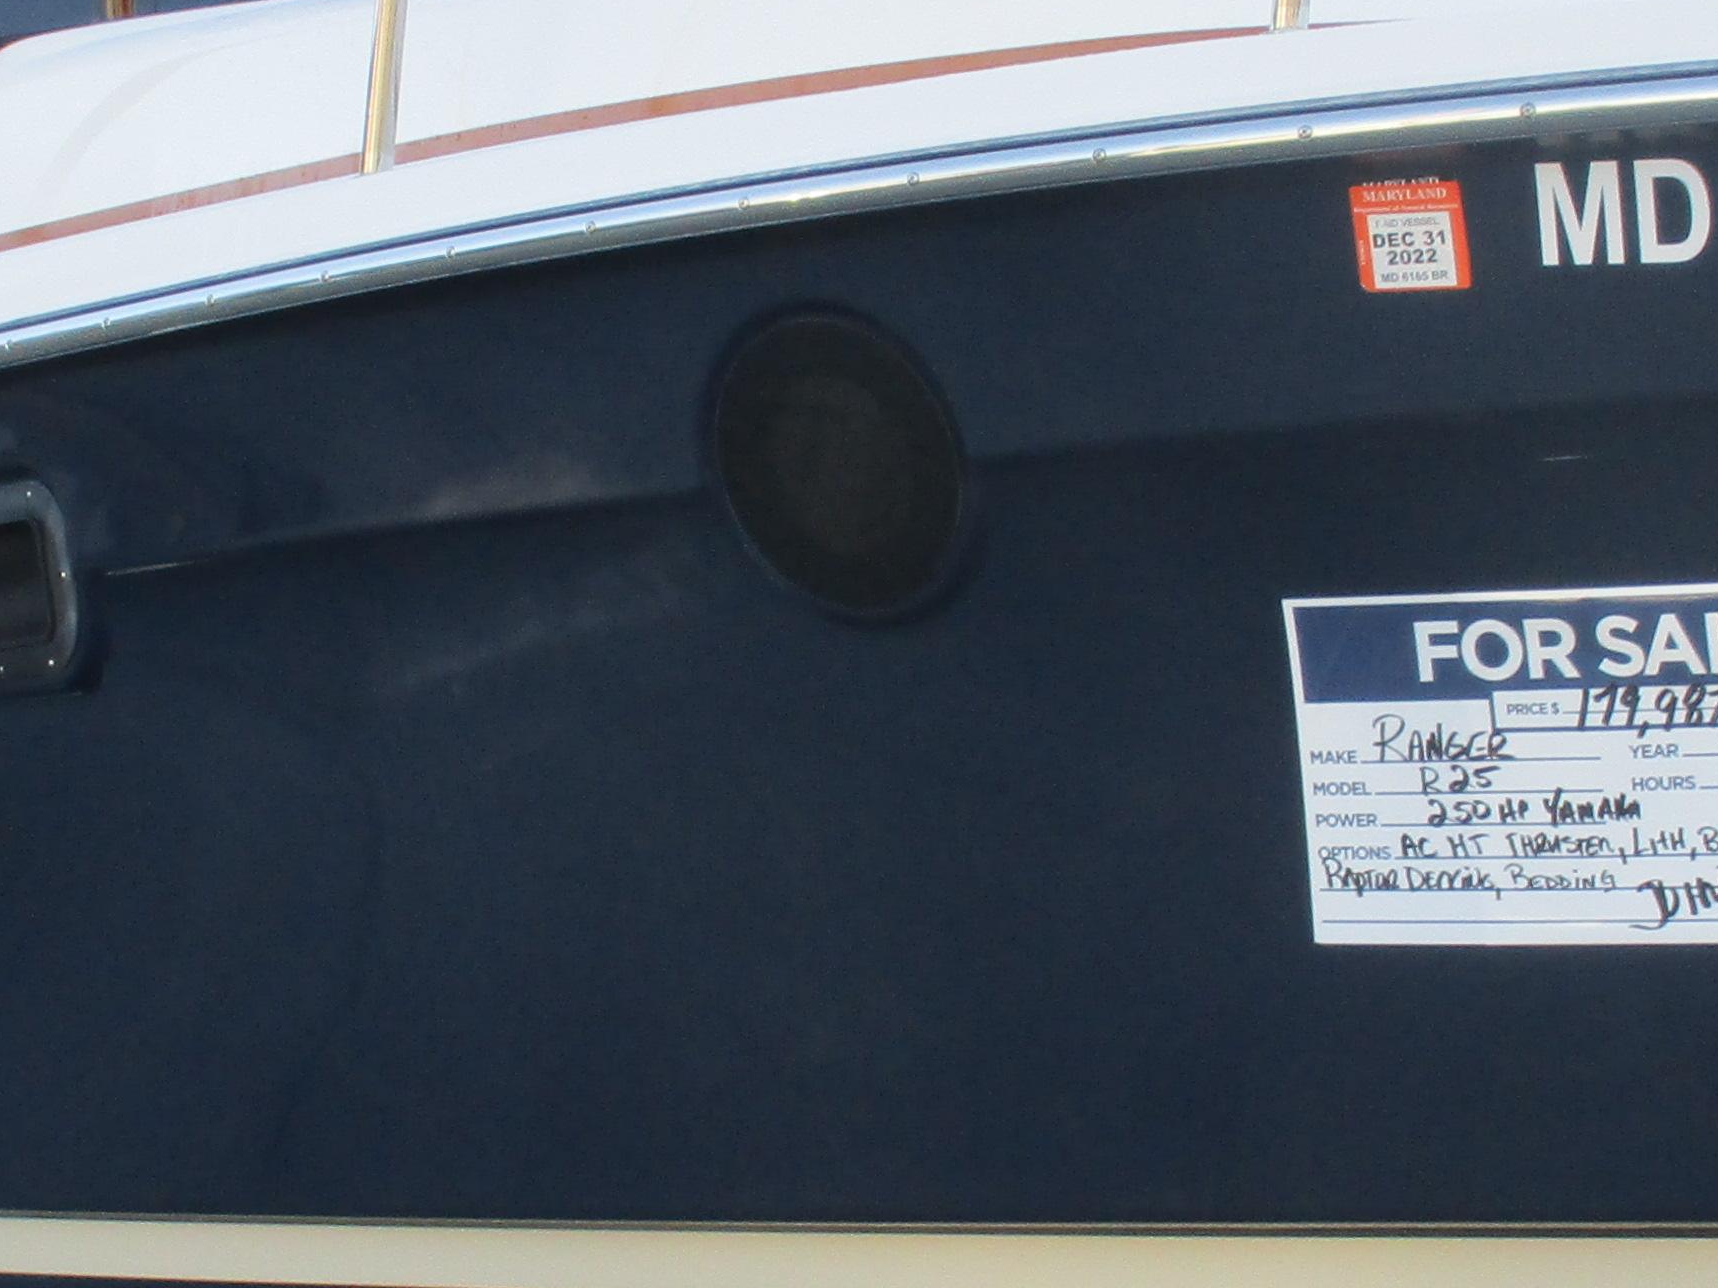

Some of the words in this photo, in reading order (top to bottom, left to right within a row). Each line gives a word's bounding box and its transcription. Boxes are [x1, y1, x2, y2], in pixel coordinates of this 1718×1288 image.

[1362, 187, 1447, 202] MARYLAND
[1534, 158, 1712, 266] MD
[1372, 231, 1415, 249] DEC
[1422, 229, 1447, 246] 31
[1386, 248, 1438, 266] 2022
[1381, 273, 1399, 283] MD
[1431, 270, 1449, 280] BR
[1413, 617, 1582, 682] FOR
[1506, 702, 1548, 716] PRICE
[1551, 701, 1560, 716] $
[1310, 750, 1360, 765] MAKE
[1628, 743, 1680, 759] YEAR
[1312, 781, 1372, 796] MODEL
[1631, 776, 1697, 791] HOURS
[1427, 798, 1492, 827] 250
[1315, 813, 1378, 828] POWER
[1318, 846, 1392, 860] OPTIONS
